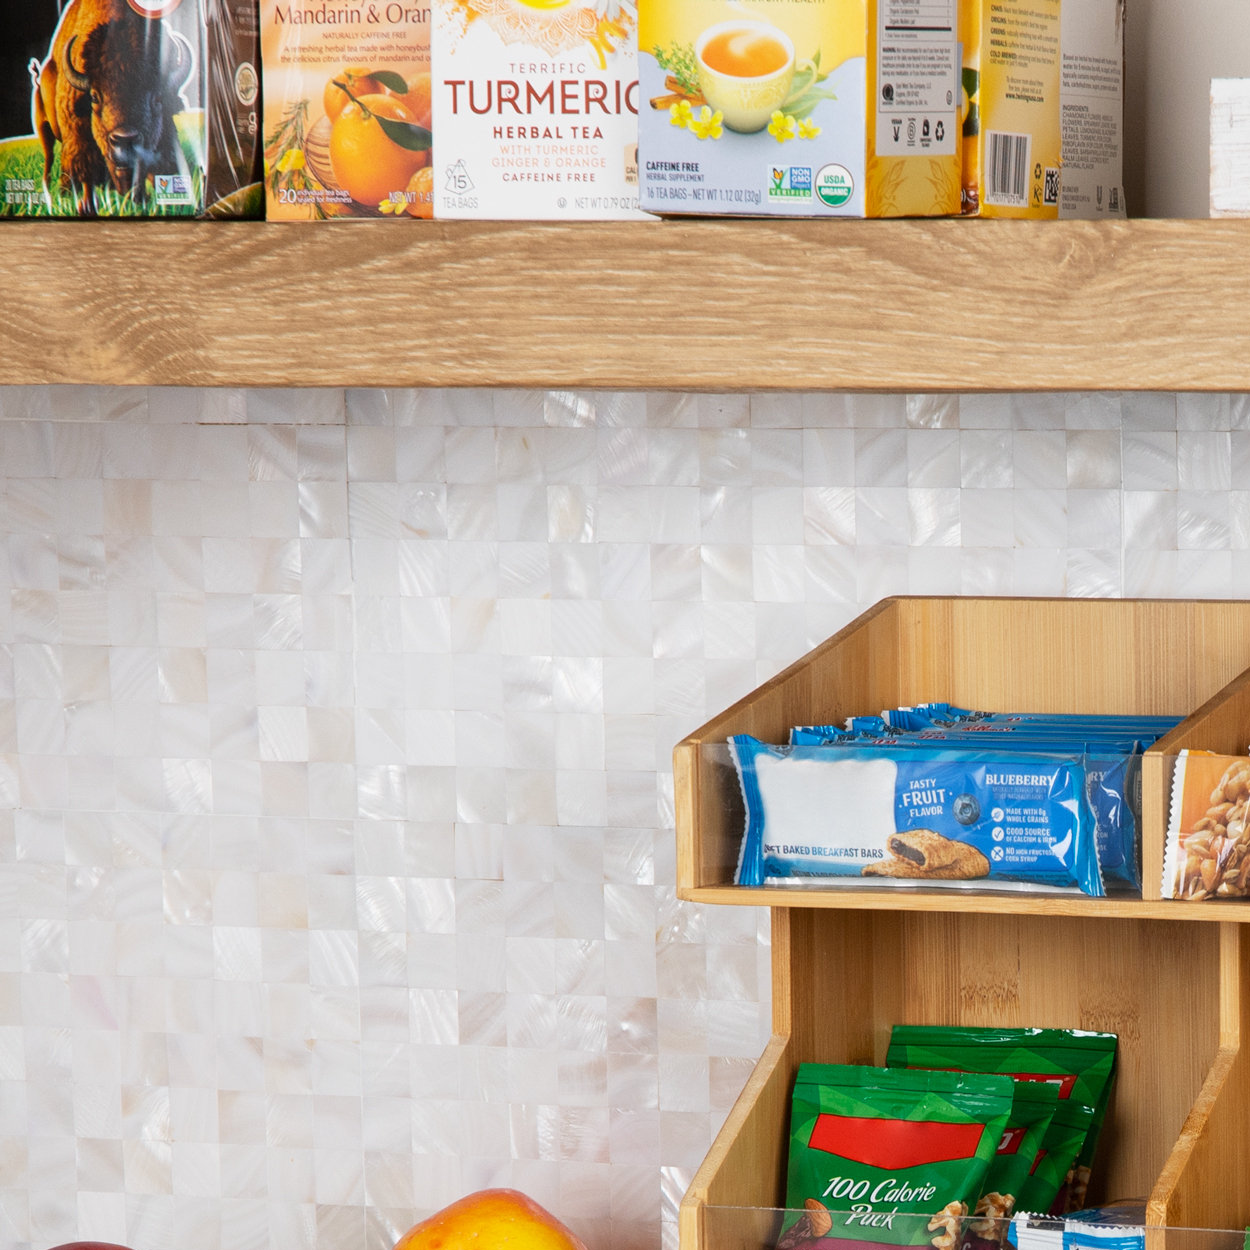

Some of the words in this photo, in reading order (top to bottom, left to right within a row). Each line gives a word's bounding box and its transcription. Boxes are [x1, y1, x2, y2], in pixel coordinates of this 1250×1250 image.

[275, 4, 360, 24] Mandarin
[366, 4, 380, 24] &
[510, 63, 586, 73] TERRIFIC
[493, 127, 563, 139] HERBAL
[571, 127, 604, 139] TEA
[499, 145, 532, 155] WITH
[536, 145, 599, 155] TURMERIC
[491, 158, 540, 168] GINGER
[555, 158, 607, 168] ORANGE
[646, 161, 680, 171] CAFFEINE
[682, 163, 700, 172] FREE
[453, 175, 467, 189] 15
[503, 173, 562, 182] CAFFEINE
[567, 173, 595, 182] FREE
[646, 173, 667, 181] HERBAL
[669, 174, 704, 182] SUPPLEMENT
[824, 175, 845, 184] USDA
[279, 189, 297, 204] 20
[389, 192, 403, 203] NET
[647, 187, 654, 197] 16
[656, 187, 668, 198] TEA
[669, 188, 687, 199] BAGS
[693, 189, 705, 200] NET
[707, 189, 717, 200] WT
[719, 190, 734, 201] 1.12
[735, 190, 744, 202] OZ
[745, 189, 761, 205] (32g)
[769, 189, 811, 197] VERIFIED
[821, 188, 848, 196] ORGANIC
[443, 197, 456, 208] TEA
[458, 197, 478, 208] BAGS
[575, 197, 588, 208] NET
[591, 197, 602, 208] WT
[620, 197, 630, 209] OZ
[909, 779, 936, 790] TASTY
[986, 774, 1055, 786] BLUEBERRY
[902, 789, 946, 807] FRUIT
[909, 805, 943, 817] FLAVOR
[1023, 808, 1038, 816] WITH
[1025, 828, 1050, 836] SOURCE
[764, 843, 781, 854] FT
[783, 845, 810, 855] BAKED
[812, 846, 858, 857] BREAKFAST
[861, 849, 883, 858] BARS
[1006, 847, 1015, 855] NO
[822, 1176, 870, 1201] 100
[870, 1178, 936, 1203] Calorie
[845, 1203, 899, 1230] Pack
